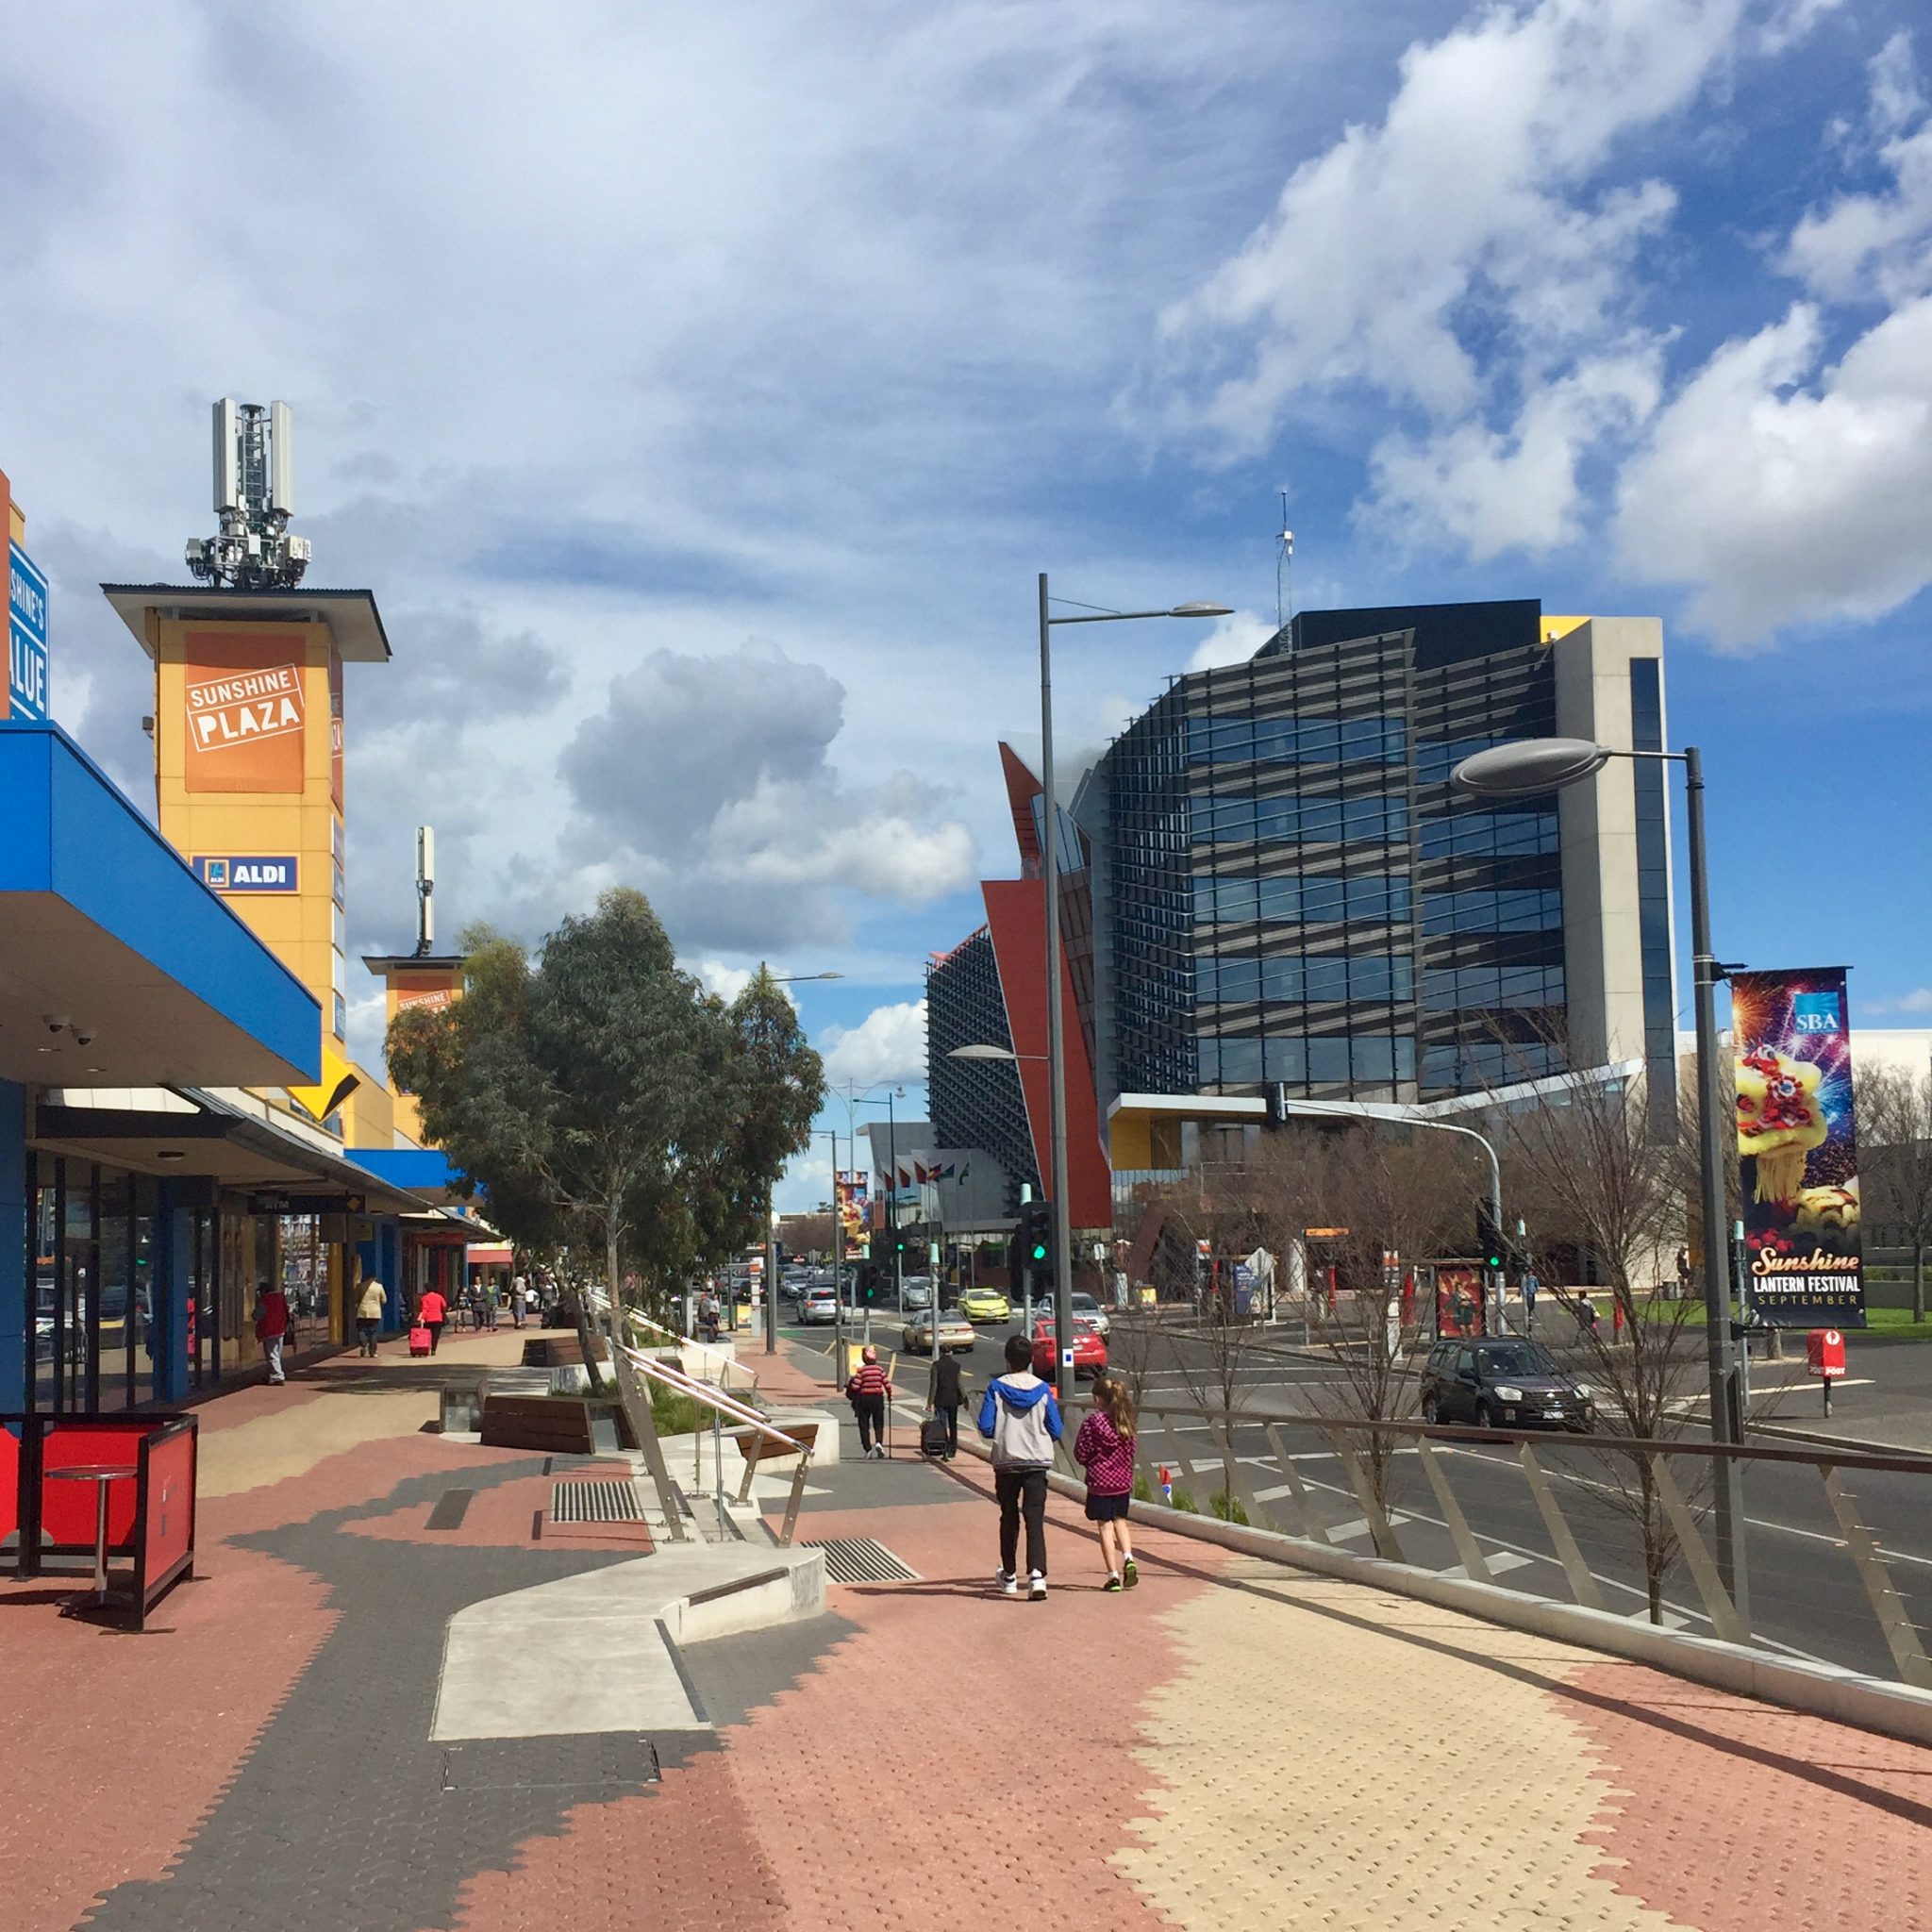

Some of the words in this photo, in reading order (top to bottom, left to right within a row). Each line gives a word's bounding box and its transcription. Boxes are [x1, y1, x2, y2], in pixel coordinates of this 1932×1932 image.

[191, 671, 291, 708] SUNSHINE
[197, 697, 300, 744] PLAZA
[233, 865, 286, 883] ALDI
[1796, 1013, 1839, 1029] SBA
[1752, 1246, 1859, 1275] Sunshine
[1753, 1276, 1806, 1293] LANTERN
[1807, 1275, 1861, 1292] FESTIVAL
[1757, 1294, 1857, 1306] SEPTEMBER
[1825, 1367, 1846, 1375] POST
